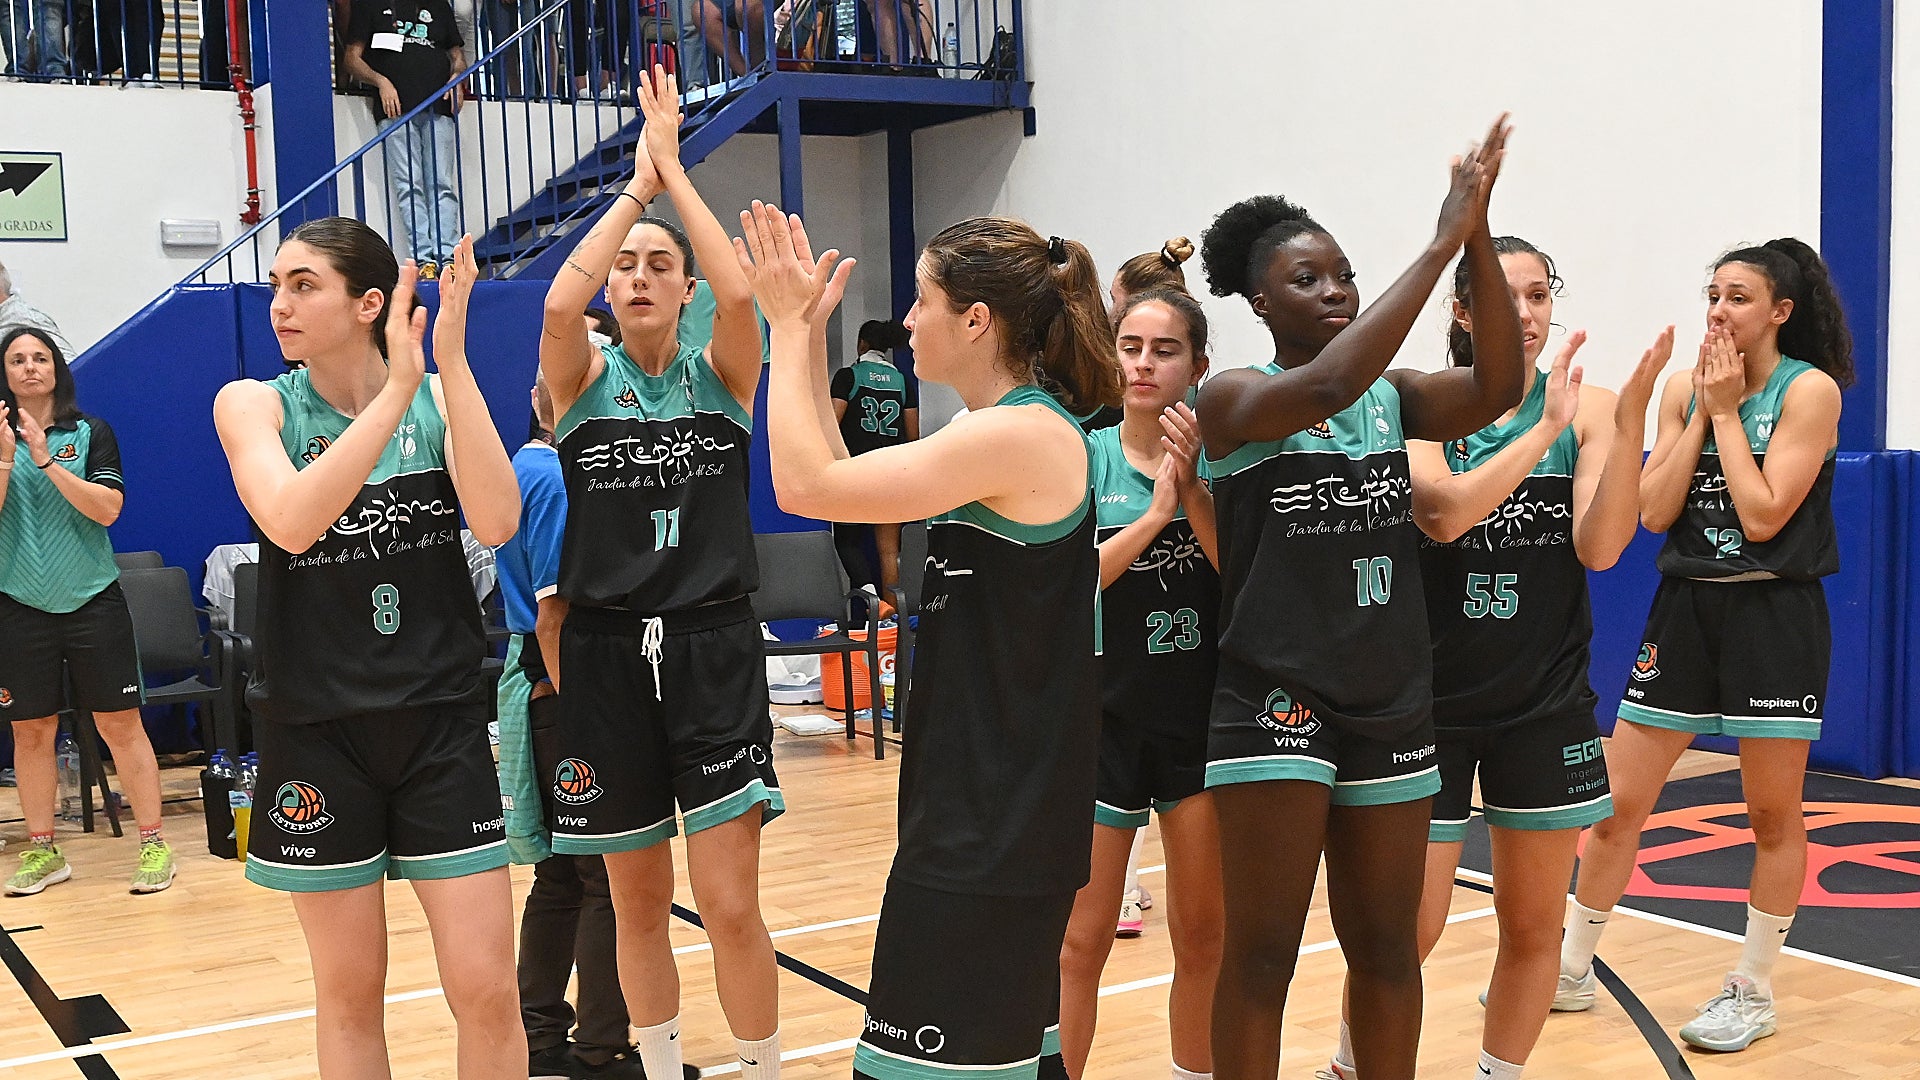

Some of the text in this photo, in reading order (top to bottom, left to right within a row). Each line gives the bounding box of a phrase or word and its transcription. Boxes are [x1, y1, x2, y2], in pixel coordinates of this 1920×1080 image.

[4, 220, 53, 232] GRADAS
[860, 396, 900, 437] 32
[628, 475, 641, 489] de
[643, 475, 656, 487] la
[650, 506, 681, 551] 11
[1333, 519, 1348, 535] de
[1349, 519, 1364, 533] la
[335, 548, 350, 564] de
[353, 546, 368, 560] la
[416, 531, 436, 549] del
[1500, 535, 1532, 549] Costa
[1703, 527, 1742, 559] 12
[1352, 556, 1392, 606] 10
[1463, 572, 1519, 619] 55
[371, 583, 400, 634] 8
[1146, 607, 1201, 654] 23
[1749, 697, 1799, 709] hospiten
[1273, 734, 1310, 749] vive
[272, 811, 330, 832] ESTEPONA
[557, 814, 588, 828] vive
[280, 844, 316, 858] vive
